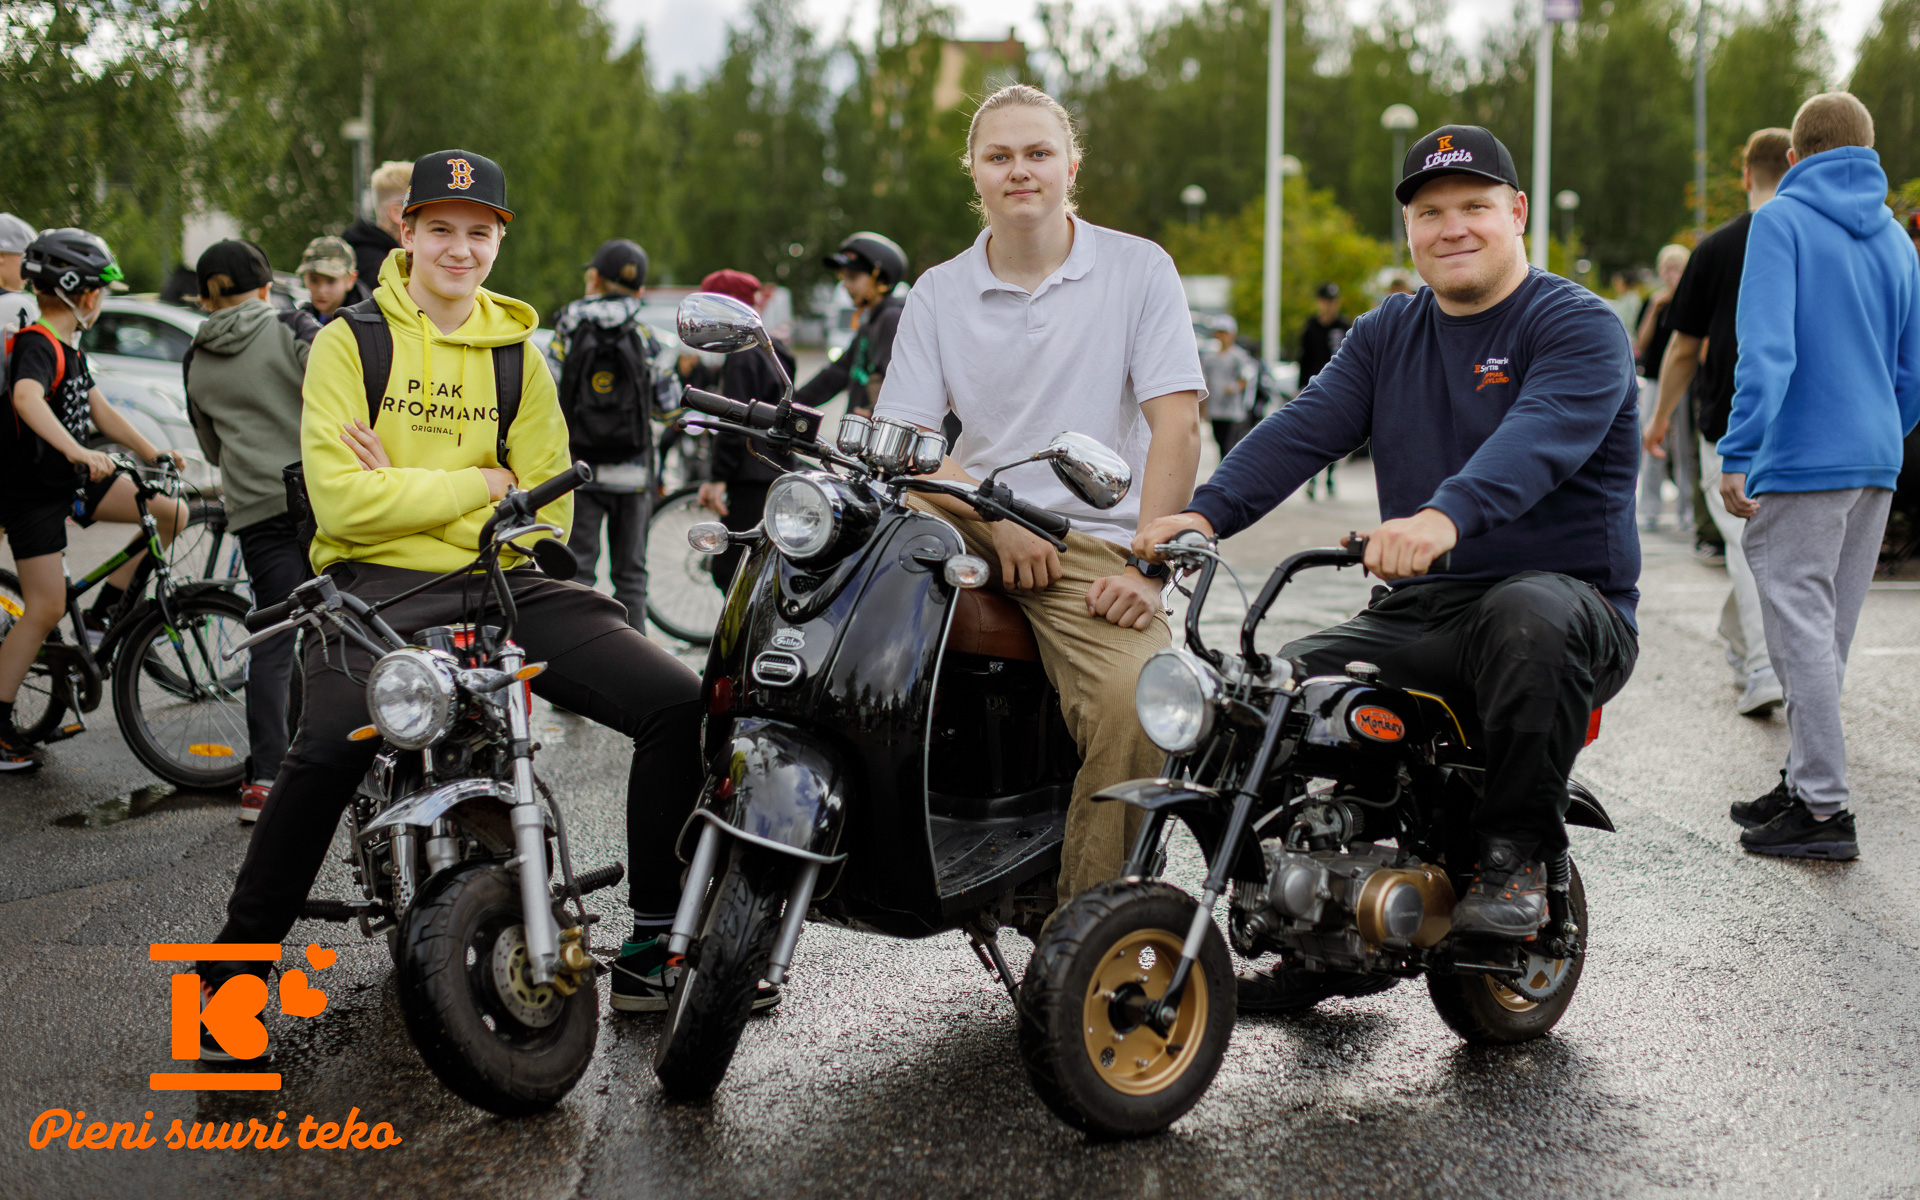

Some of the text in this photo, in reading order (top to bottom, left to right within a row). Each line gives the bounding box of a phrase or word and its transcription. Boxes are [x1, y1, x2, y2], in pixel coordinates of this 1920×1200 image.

[1422, 149, 1473, 170] Löytis
[446, 158, 476, 190] B
[411, 424, 454, 435] ORIGINAL
[1360, 713, 1402, 736] Monkey
